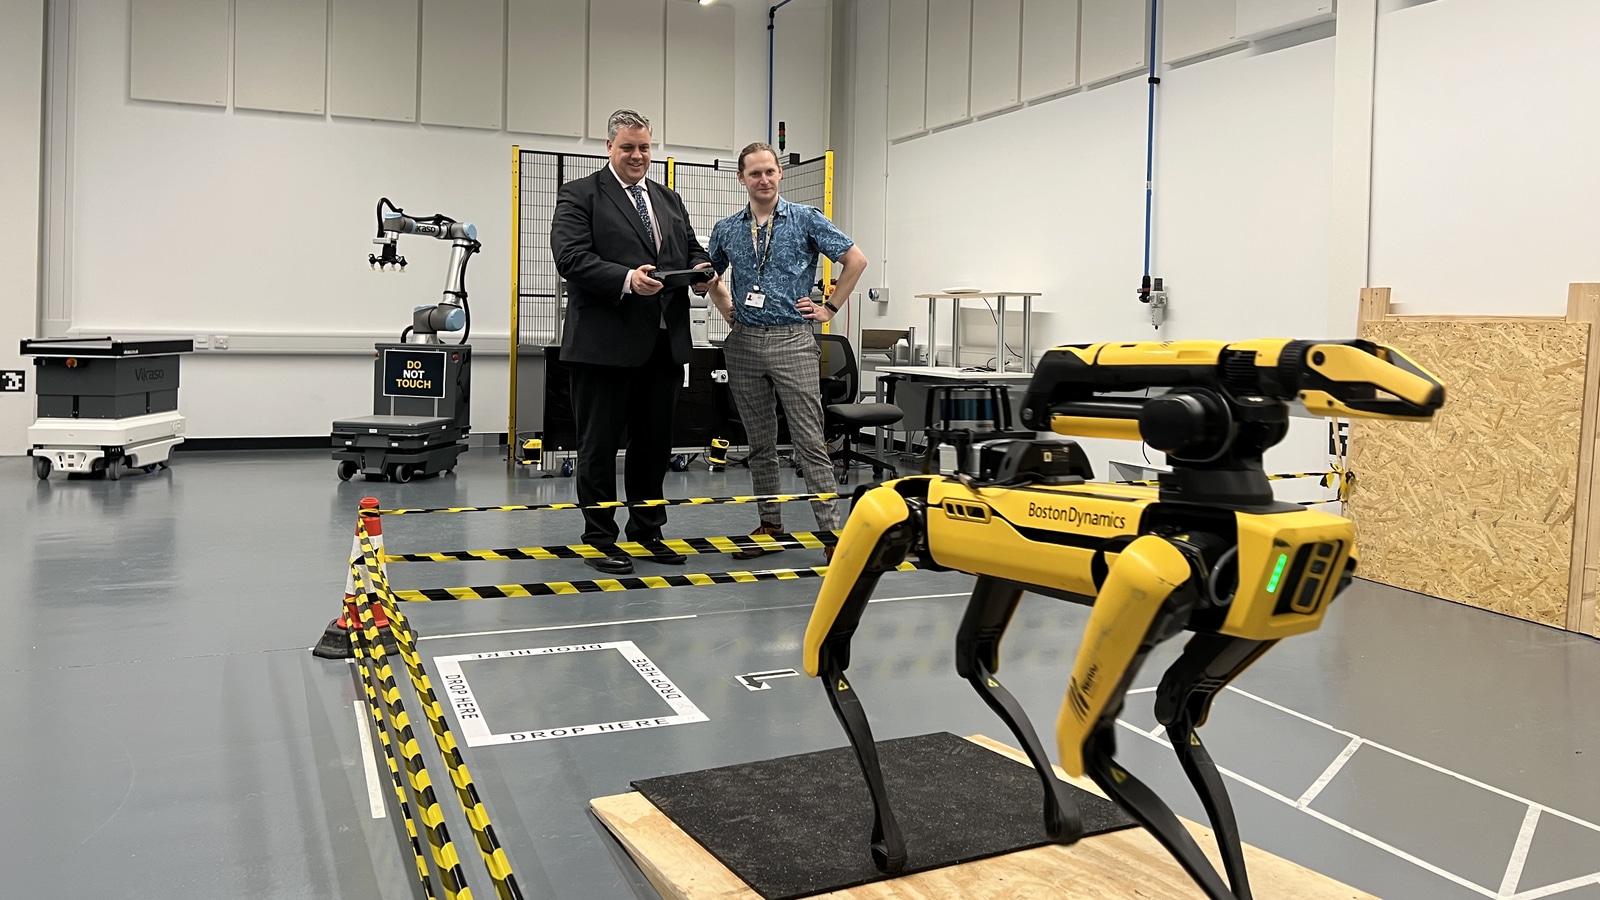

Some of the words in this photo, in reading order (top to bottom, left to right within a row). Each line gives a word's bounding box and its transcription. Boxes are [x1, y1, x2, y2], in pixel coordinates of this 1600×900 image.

[406, 360, 422, 370] DO
[134, 367, 165, 382] Vikaso
[403, 369, 426, 379] NOT
[395, 379, 432, 389] TOUCH
[471, 650, 531, 659] HERE
[542, 644, 602, 653] DROP
[632, 658, 660, 677] HERE
[445, 674, 468, 694] DROP
[651, 679, 682, 699] DROP
[454, 697, 479, 719] HERE
[510, 727, 585, 741] DROP
[598, 717, 670, 731] HERE
